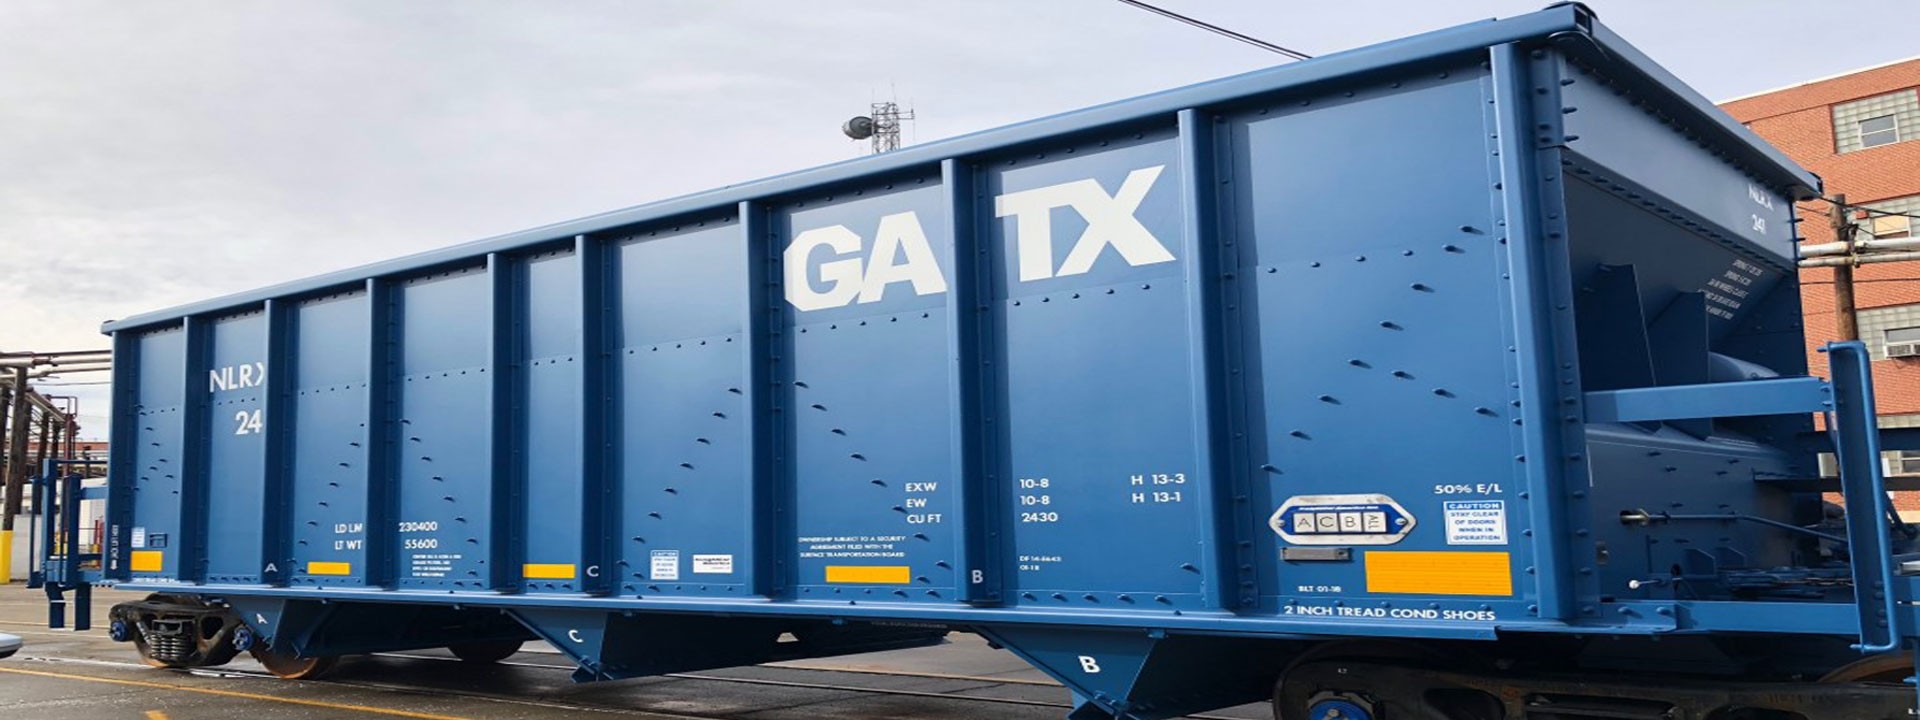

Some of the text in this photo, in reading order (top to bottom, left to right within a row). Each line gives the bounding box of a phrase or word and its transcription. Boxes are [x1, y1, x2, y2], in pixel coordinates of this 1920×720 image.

[905, 478, 1049, 492] EXW 10-8
[1131, 473, 1185, 485] H 13-3
[1434, 483, 1503, 495] 50% E/L
[906, 495, 1050, 508] EW 10-8
[1132, 491, 1181, 503] H 13-1
[907, 511, 1058, 524] CU FT 2430
[1297, 517, 1312, 528] A
[1319, 516, 1334, 528] C
[1345, 516, 1356, 528] B
[335, 524, 347, 533] LD
[399, 521, 438, 532] 230400
[335, 539, 438, 550] LT WT 55600
[264, 562, 278, 573] A
[586, 565, 599, 577] C
[972, 570, 984, 584] B
[256, 612, 268, 625] A
[1284, 606, 1496, 621] 2 INCH TREAD COND SHOES
[568, 629, 584, 643] C
[1078, 655, 1100, 673] B
